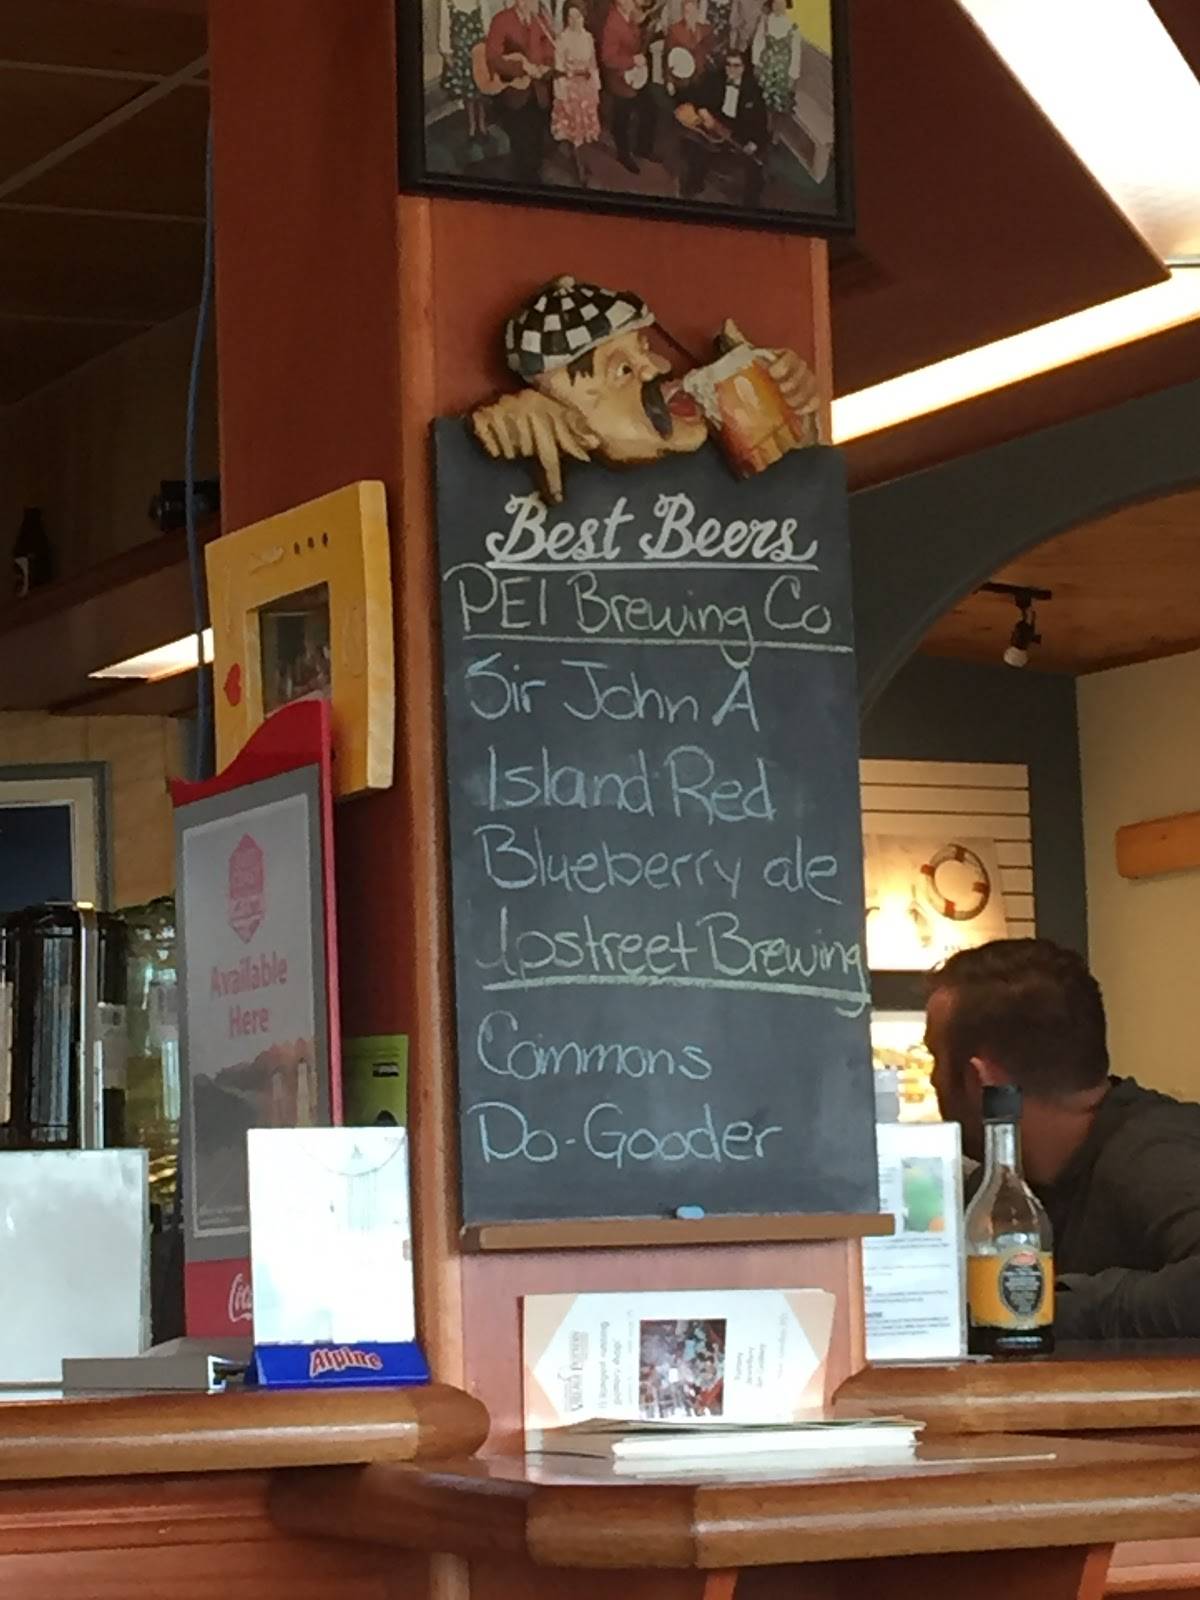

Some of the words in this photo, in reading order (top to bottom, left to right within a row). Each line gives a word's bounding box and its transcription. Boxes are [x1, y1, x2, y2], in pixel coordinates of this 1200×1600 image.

[485, 493, 634, 561] Best
[639, 493, 818, 561] Beers
[443, 563, 547, 631] PEI
[567, 571, 755, 669] Brewing
[765, 575, 831, 634] Co
[465, 652, 546, 721] Sir
[562, 659, 699, 723] John
[712, 669, 760, 732] A
[488, 746, 655, 817] Island
[664, 746, 776, 825] Red
[473, 824, 742, 899] Blueberry
[763, 835, 842, 903] ale
[211, 952, 289, 998] Available
[697, 911, 870, 1018] Brewing
[229, 1006, 270, 1039] Here
[477, 1010, 713, 1081] Commons
[467, 1101, 783, 1169] Do-Gooder
[309, 1346, 384, 1378] Alpine
